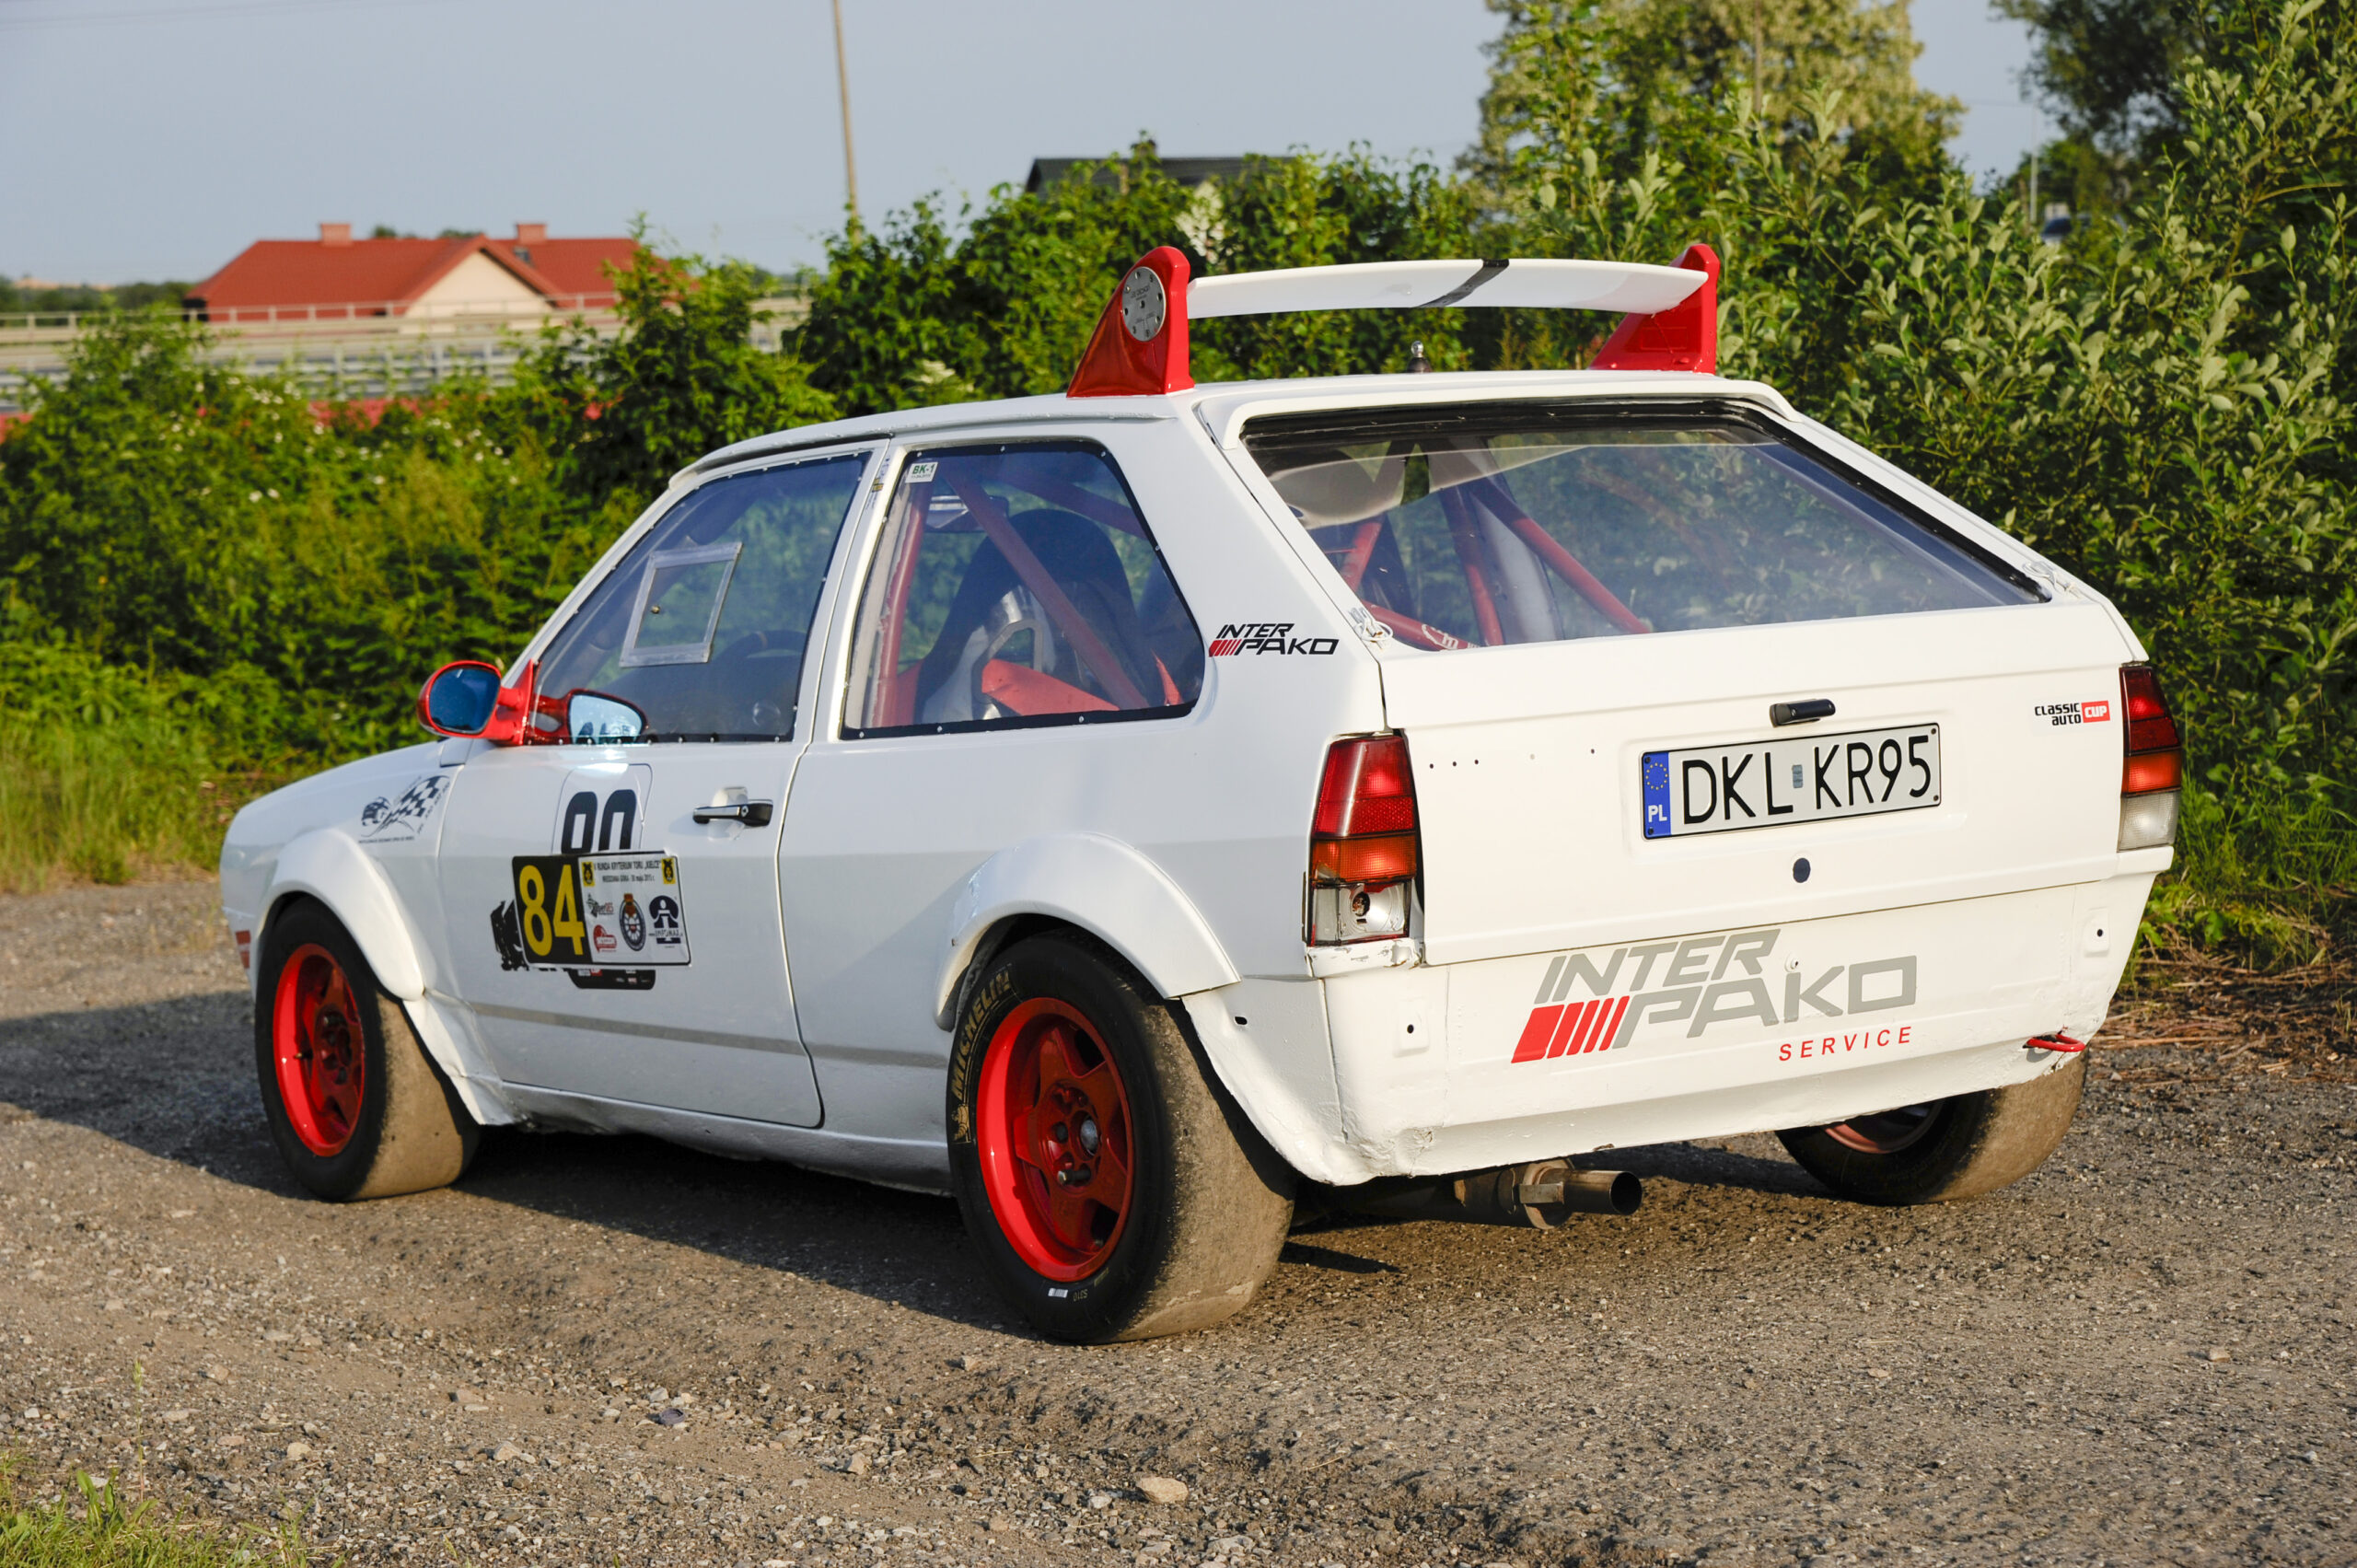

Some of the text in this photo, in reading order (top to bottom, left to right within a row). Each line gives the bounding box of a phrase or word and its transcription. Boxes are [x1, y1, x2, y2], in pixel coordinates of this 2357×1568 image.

[1216, 623, 1295, 639] INTER
[1234, 638, 1340, 656] PAKO
[2084, 705, 2107, 718] CUP
[1682, 735, 1932, 825] DKL KR95
[1647, 805, 1667, 822] PL
[519, 864, 586, 957] 84
[1534, 928, 1781, 1005] INTER
[1611, 955, 1918, 1050] PAKO
[951, 970, 1011, 1101] MICHELIN
[1778, 1026, 1912, 1062] SERVICE
